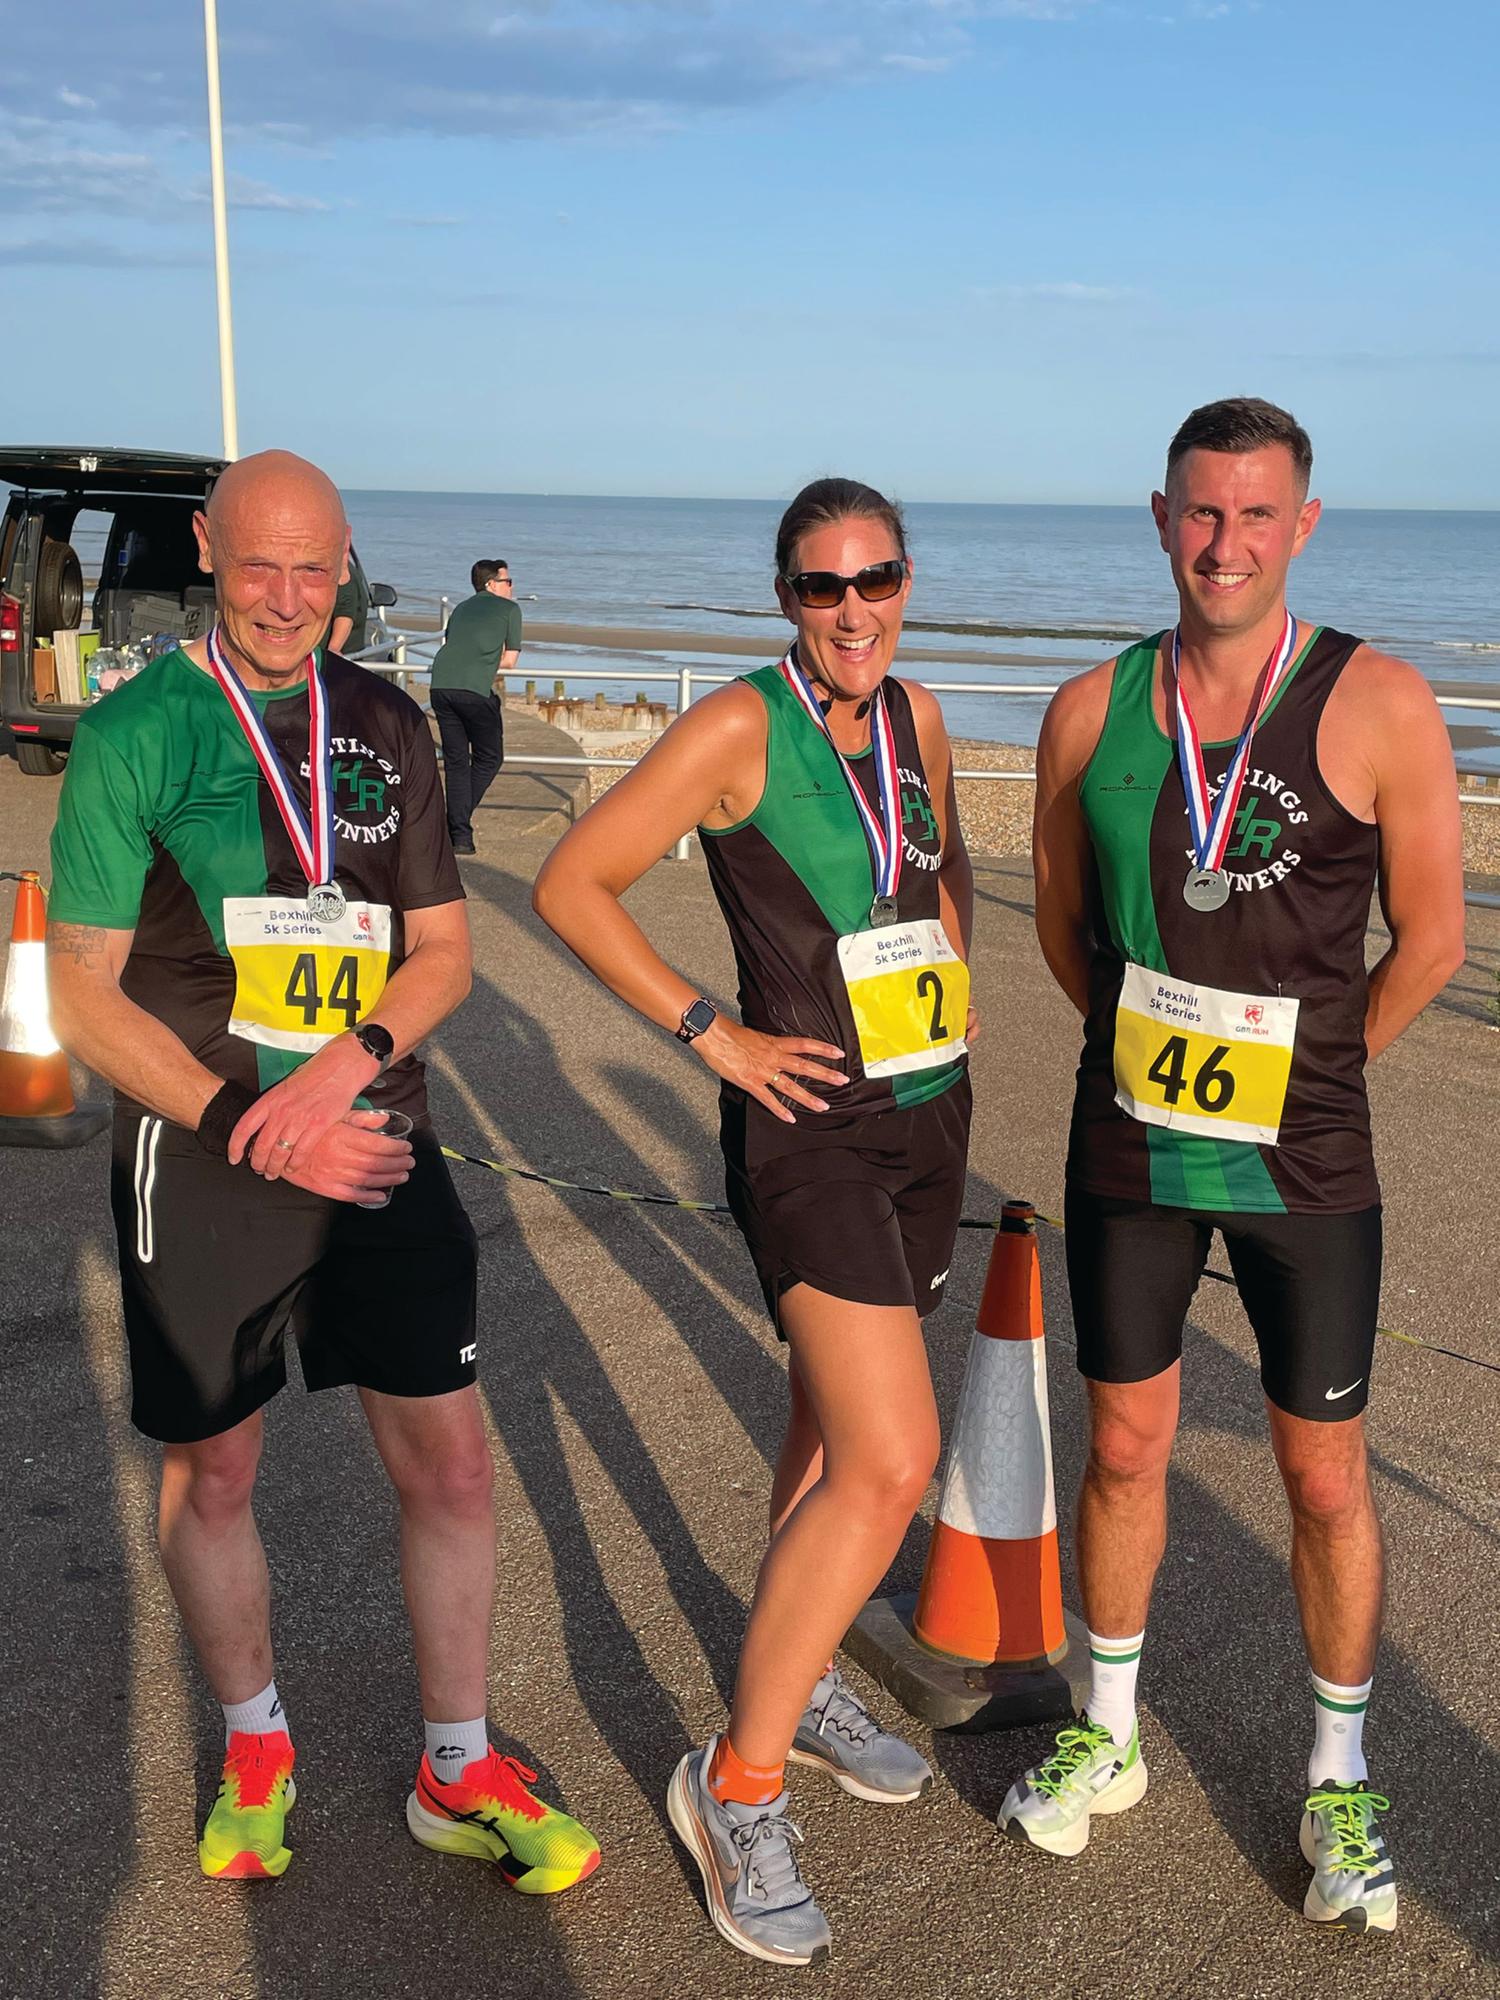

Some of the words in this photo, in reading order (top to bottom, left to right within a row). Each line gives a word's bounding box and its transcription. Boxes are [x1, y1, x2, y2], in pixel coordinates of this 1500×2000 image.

[264, 924, 279, 934] 5k
[283, 923, 322, 935] Series
[877, 934, 915, 951] Bexhill
[875, 954, 889, 965] 5k
[891, 947, 922, 962] Series
[285, 953, 361, 1027] 44
[1157, 986, 1198, 1007] Bexhill
[917, 970, 949, 1042] 2
[1149, 998, 1163, 1011] 5k
[1165, 1003, 1202, 1022] Series
[1147, 1035, 1236, 1113] 46
